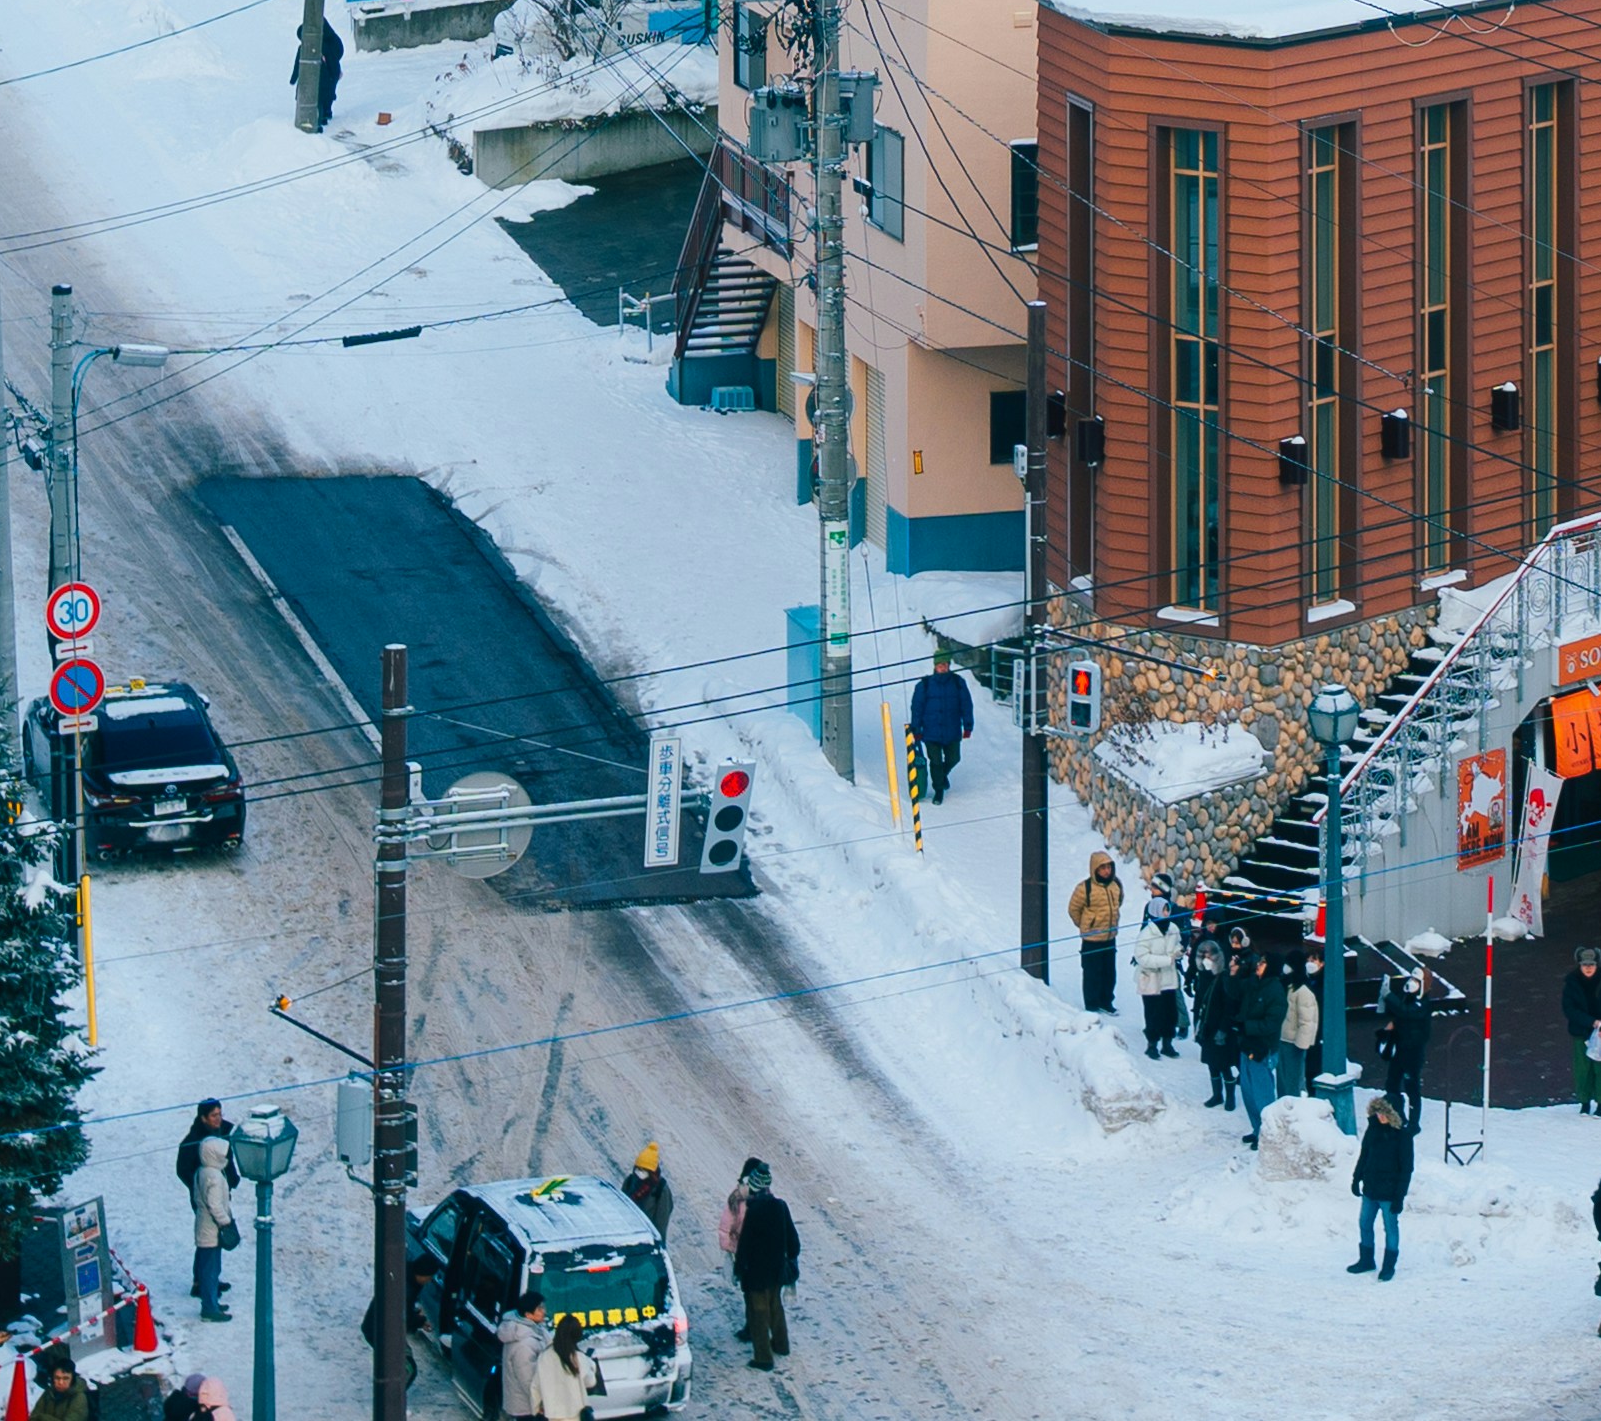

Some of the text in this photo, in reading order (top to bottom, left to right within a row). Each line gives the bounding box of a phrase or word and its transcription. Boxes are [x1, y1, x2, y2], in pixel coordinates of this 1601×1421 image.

[59, 598, 89, 625] 30
[655, 744, 675, 859] 歩車分離式信号
